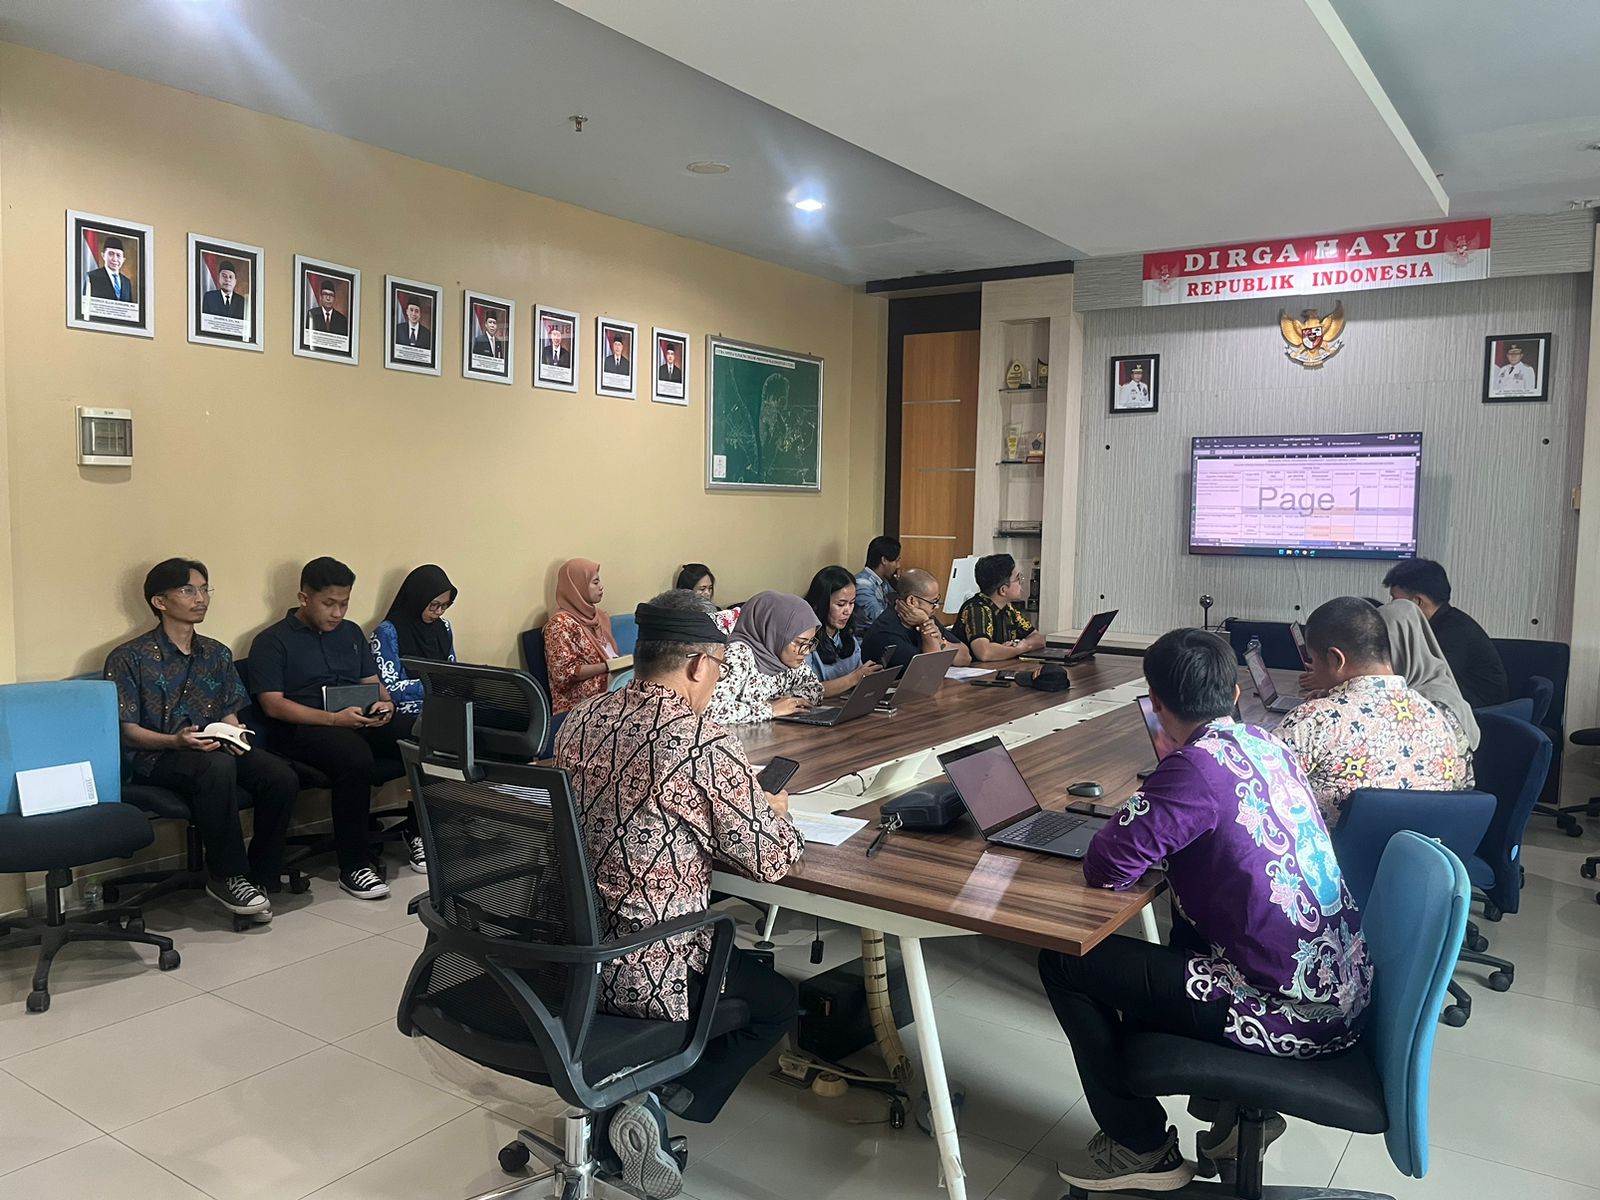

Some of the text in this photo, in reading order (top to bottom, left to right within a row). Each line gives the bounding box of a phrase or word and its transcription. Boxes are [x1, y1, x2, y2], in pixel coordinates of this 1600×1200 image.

[1187, 262, 1433, 297] REPUBLIK INDONESIA
[1258, 486, 1335, 517] Page
[1349, 486, 1361, 511] 1
